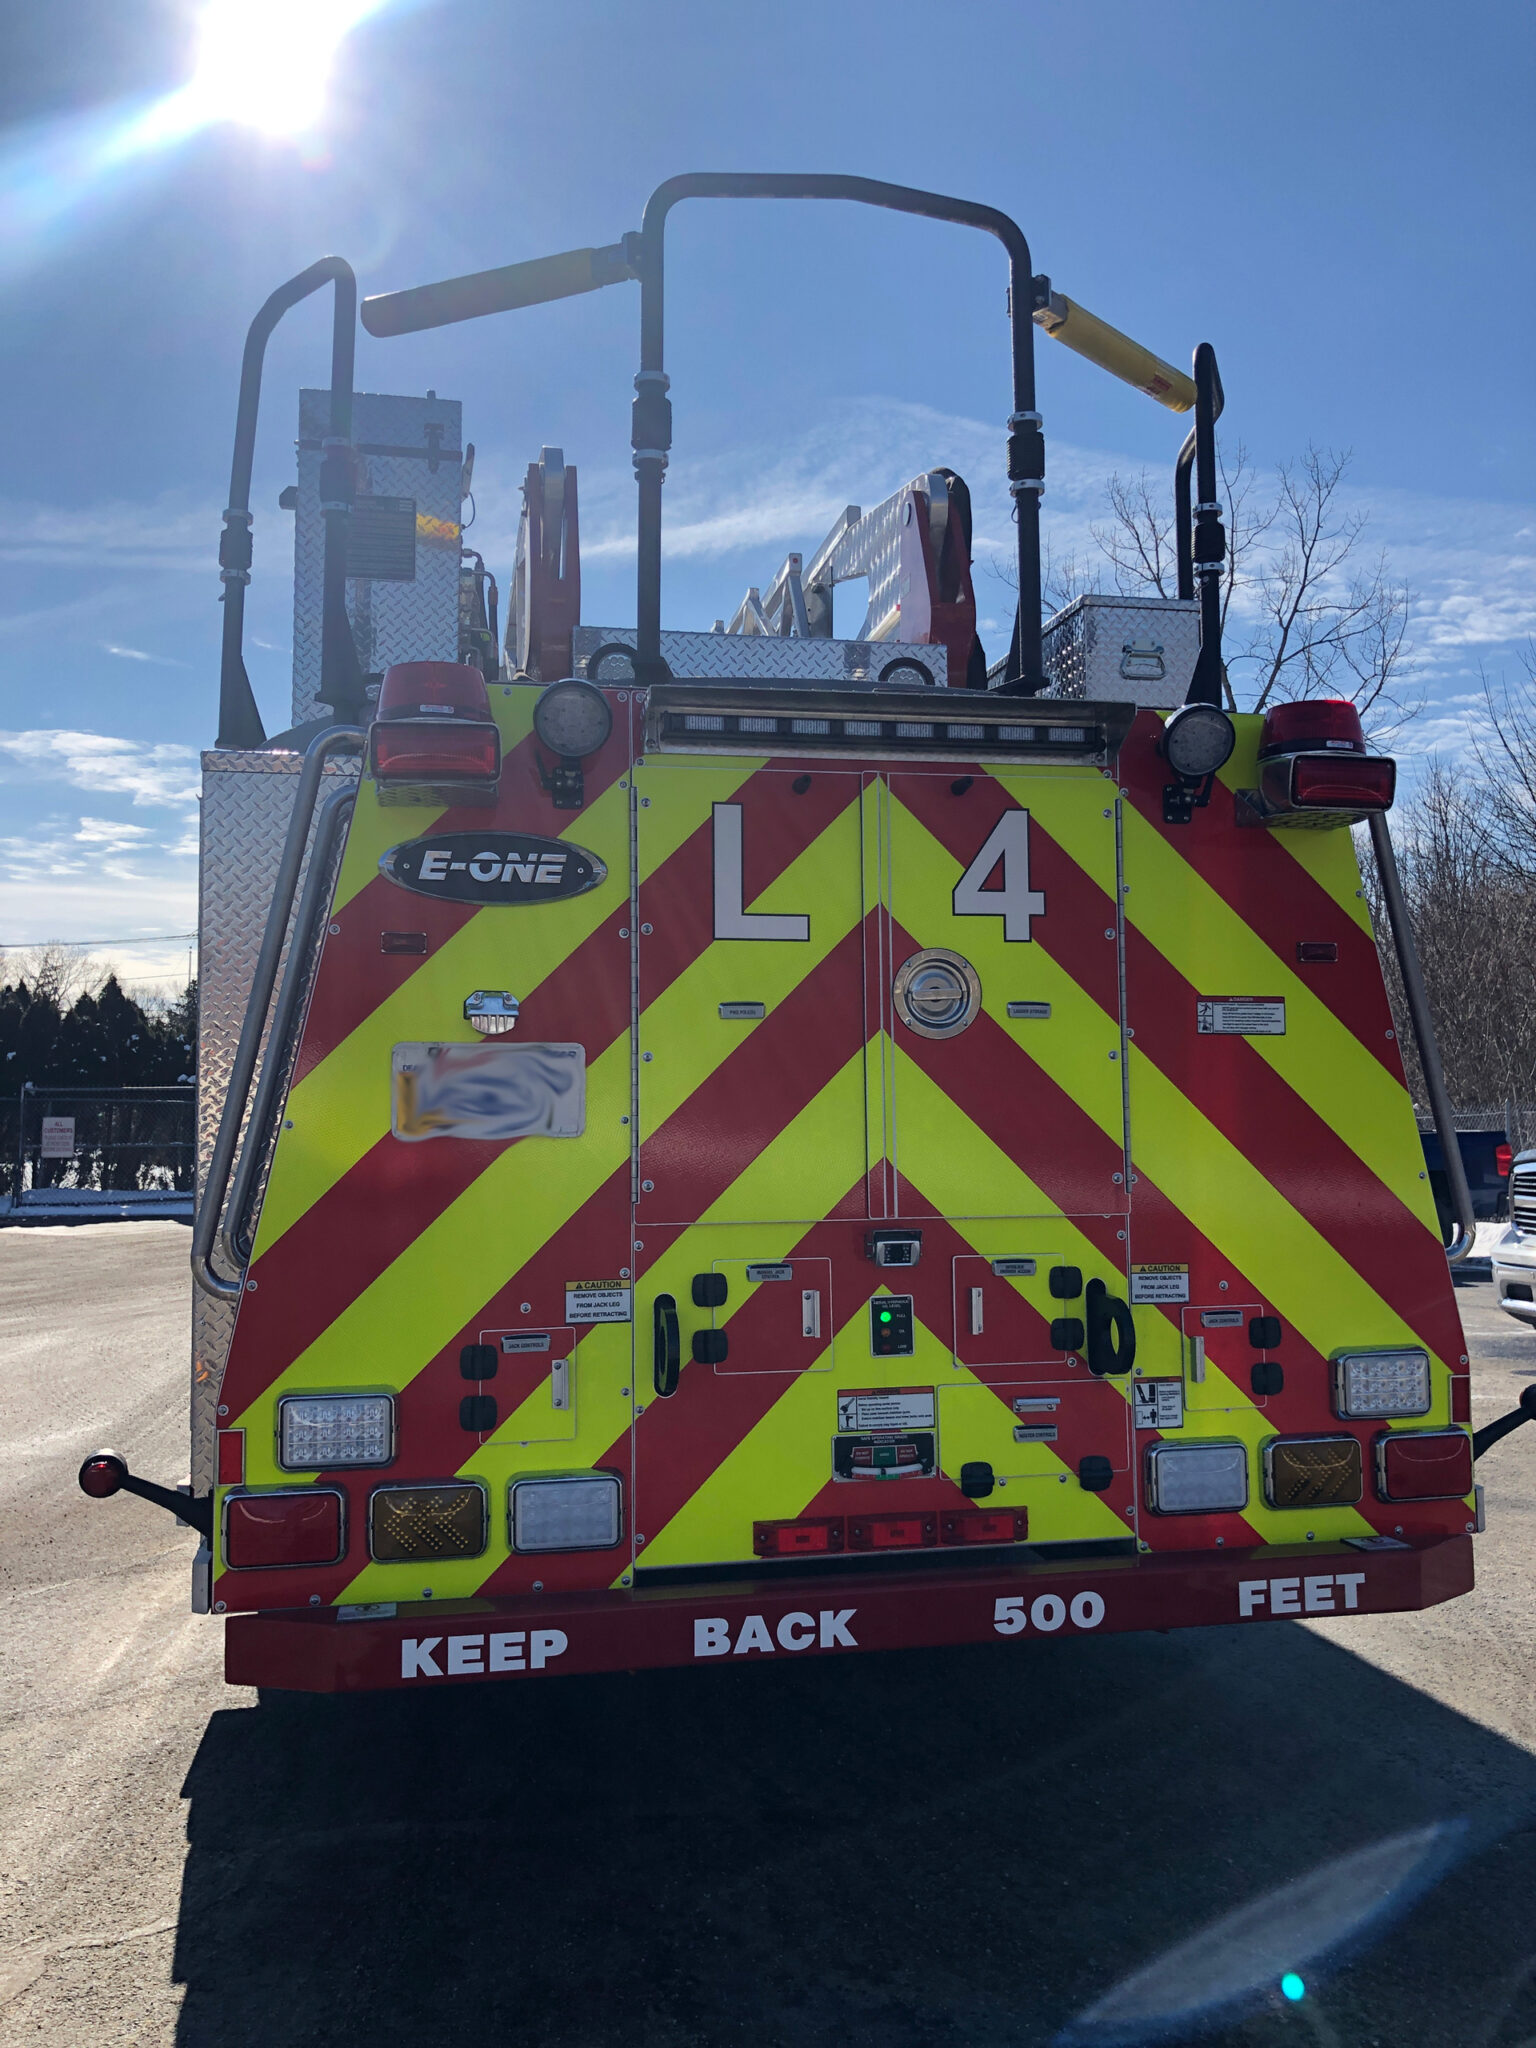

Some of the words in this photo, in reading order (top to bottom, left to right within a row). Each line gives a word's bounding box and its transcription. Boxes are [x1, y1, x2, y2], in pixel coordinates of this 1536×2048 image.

[418, 850, 567, 884] E-ONE
[712, 801, 811, 942] L
[952, 808, 1046, 942] 4
[584, 1281, 622, 1289] CAUTION
[401, 1629, 568, 1679] KEEP
[693, 1608, 859, 1657] BACK
[993, 1591, 1105, 1635] 500
[1239, 1573, 1366, 1617] FEET
